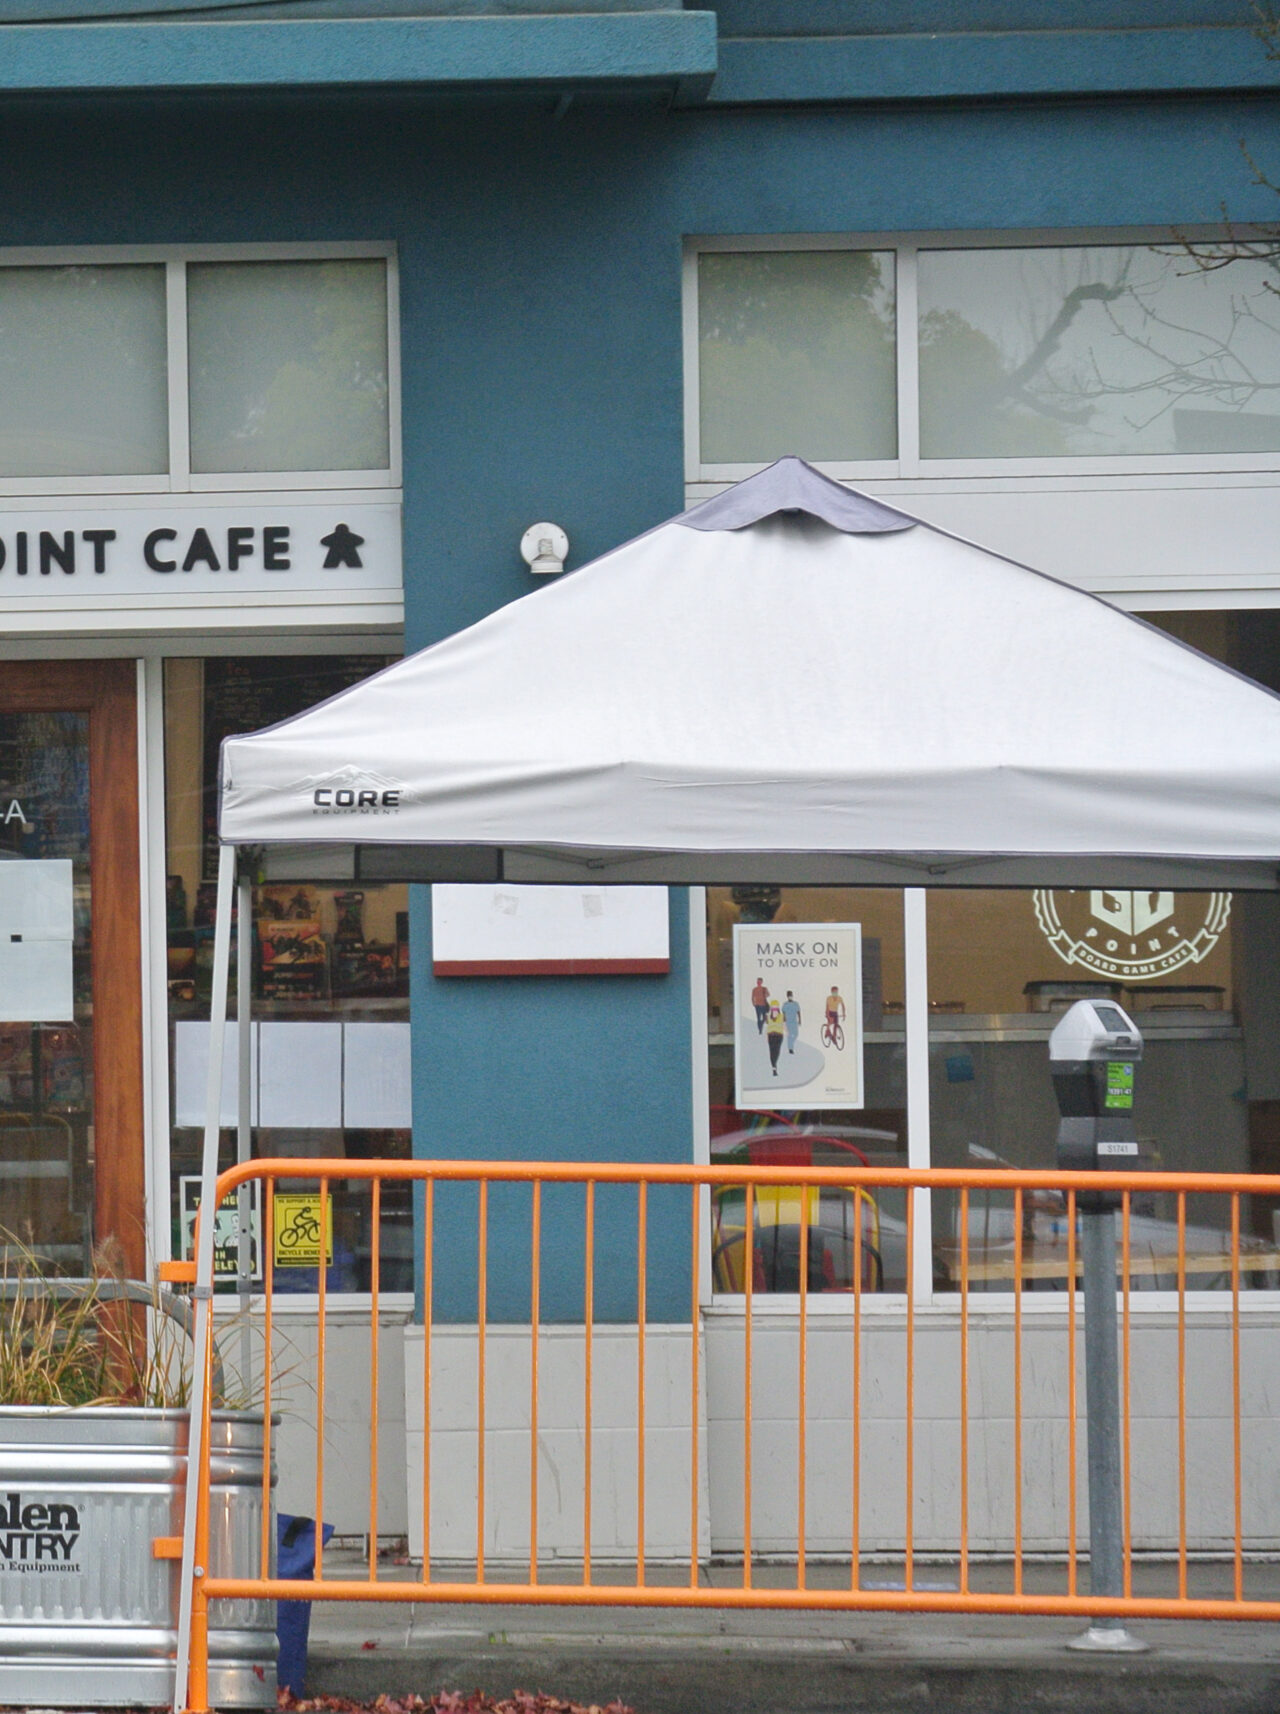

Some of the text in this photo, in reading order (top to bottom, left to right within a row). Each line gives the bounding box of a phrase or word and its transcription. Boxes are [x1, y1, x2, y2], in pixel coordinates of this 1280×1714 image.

[144, 527, 290, 573] CAFE
[314, 789, 400, 807] CORE
[1085, 925, 1179, 955] POINT
[756, 942, 838, 955] MASK ON
[757, 958, 839, 968] TO MOVE ON
[1079, 948, 1188, 975] BOARD GAME CAFE
[1106, 1145, 1129, 1153] S1741
[8, 1561, 81, 1574] Equipment
